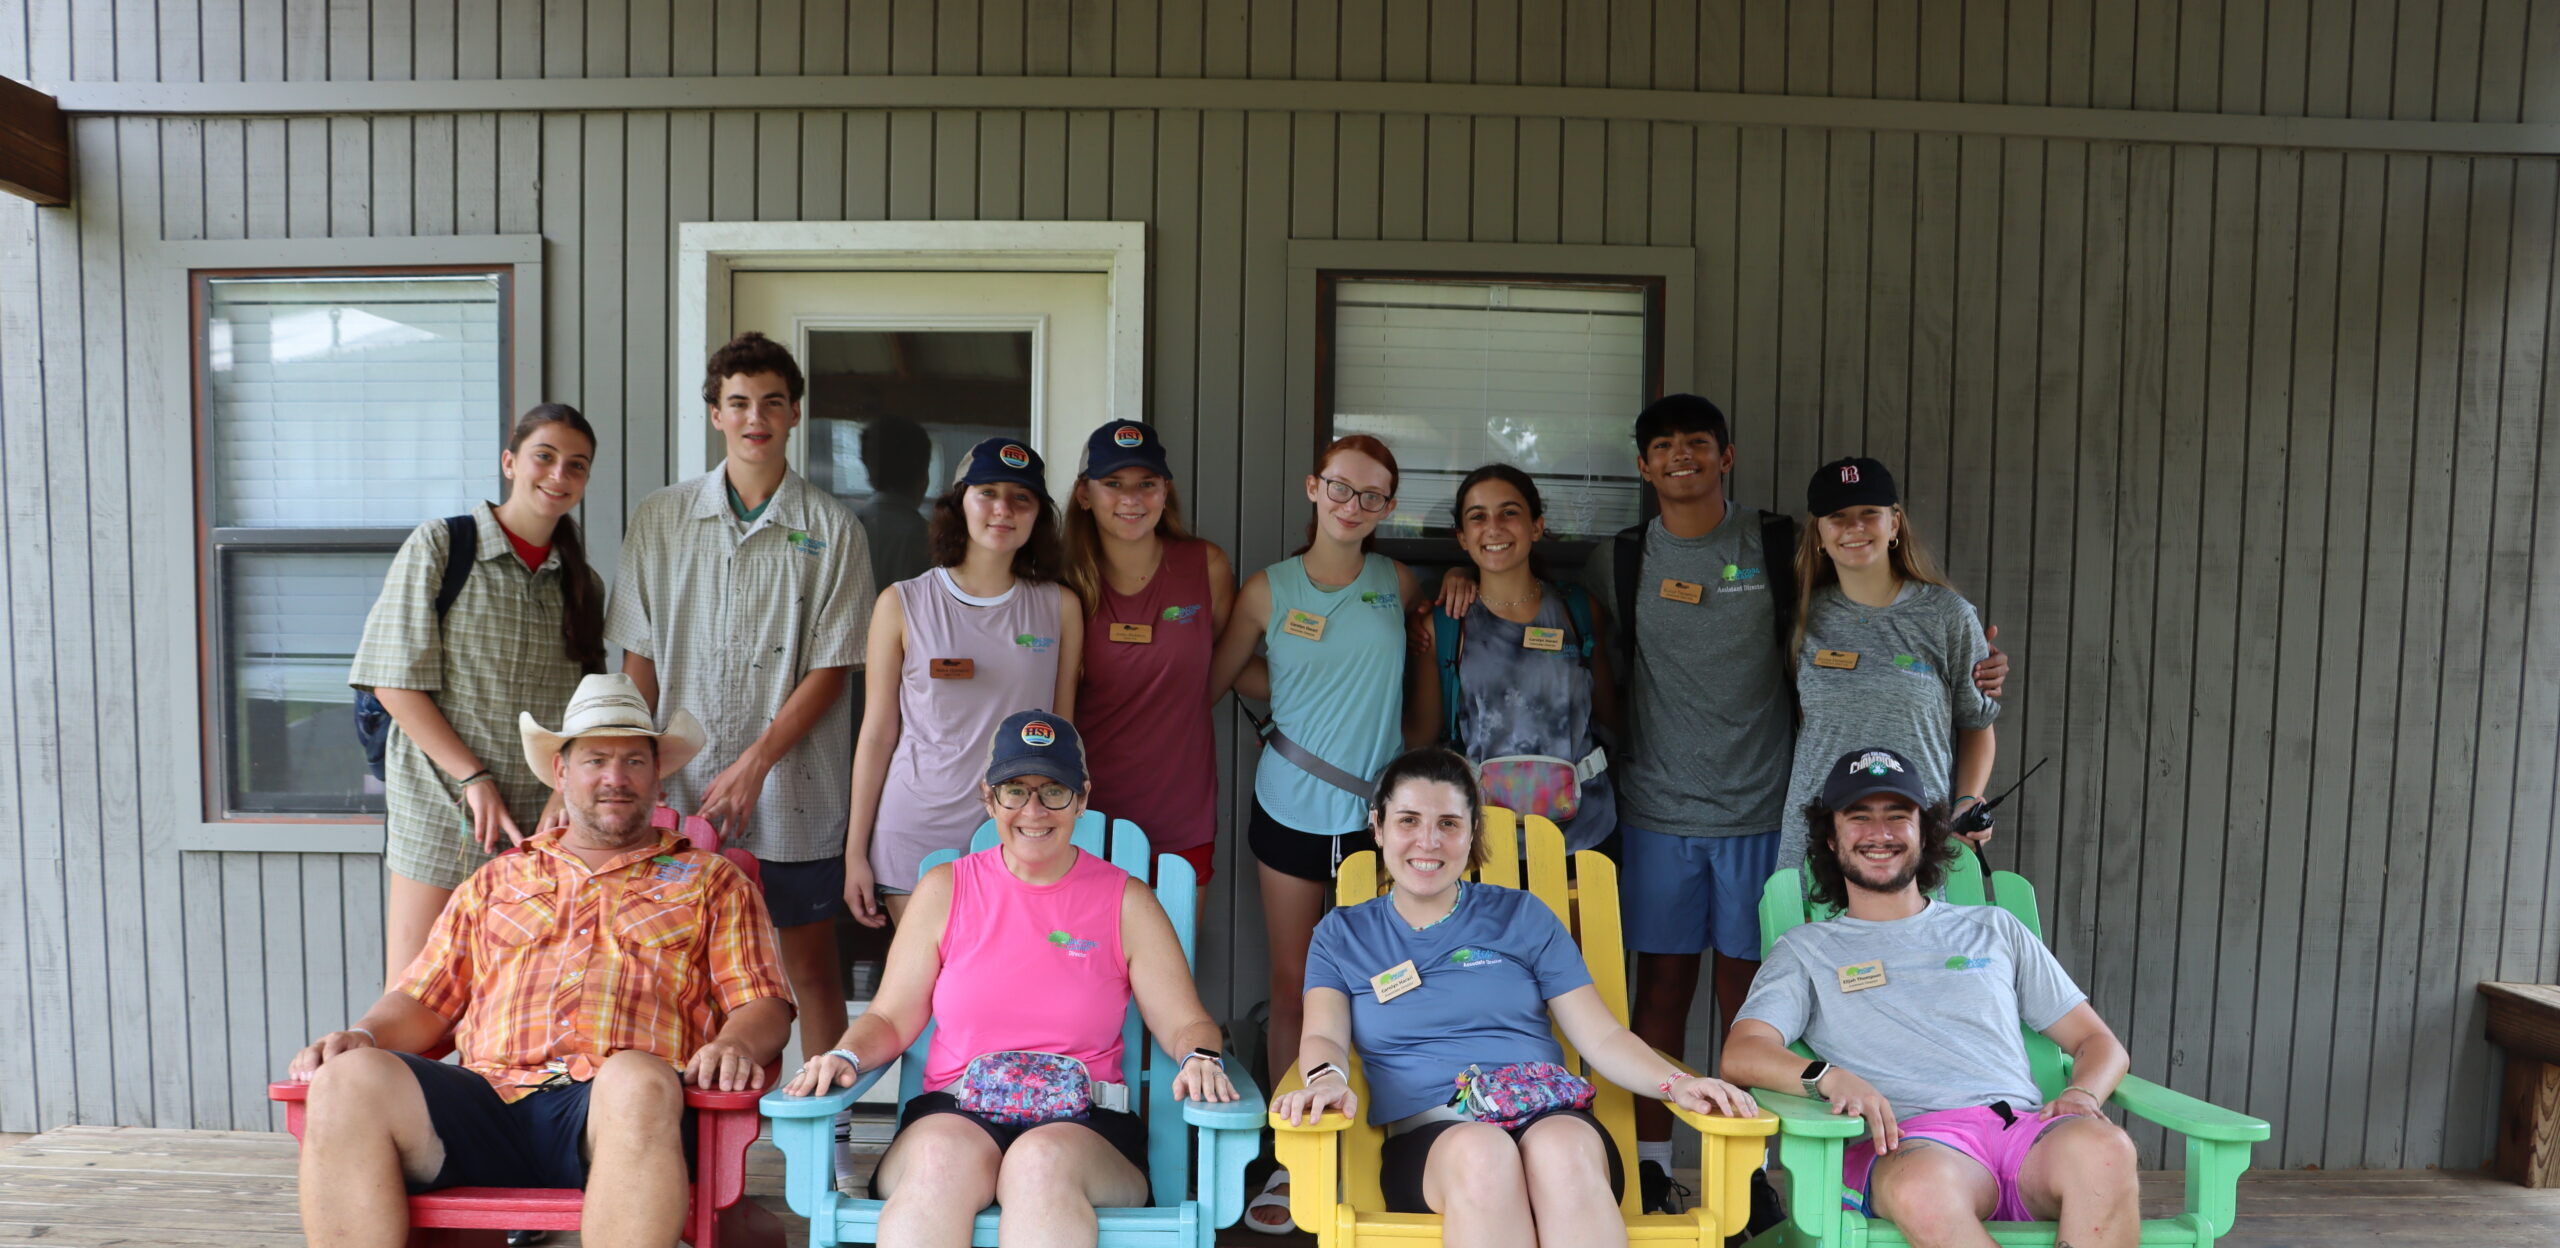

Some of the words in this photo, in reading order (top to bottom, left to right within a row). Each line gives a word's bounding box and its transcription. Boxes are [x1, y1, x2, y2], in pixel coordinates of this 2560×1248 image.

[1840, 465, 1860, 484] B
[1743, 584, 1765, 592] Director
[1025, 727, 1053, 739] HSJ
[1849, 756, 1905, 775] CHAMPIONS
